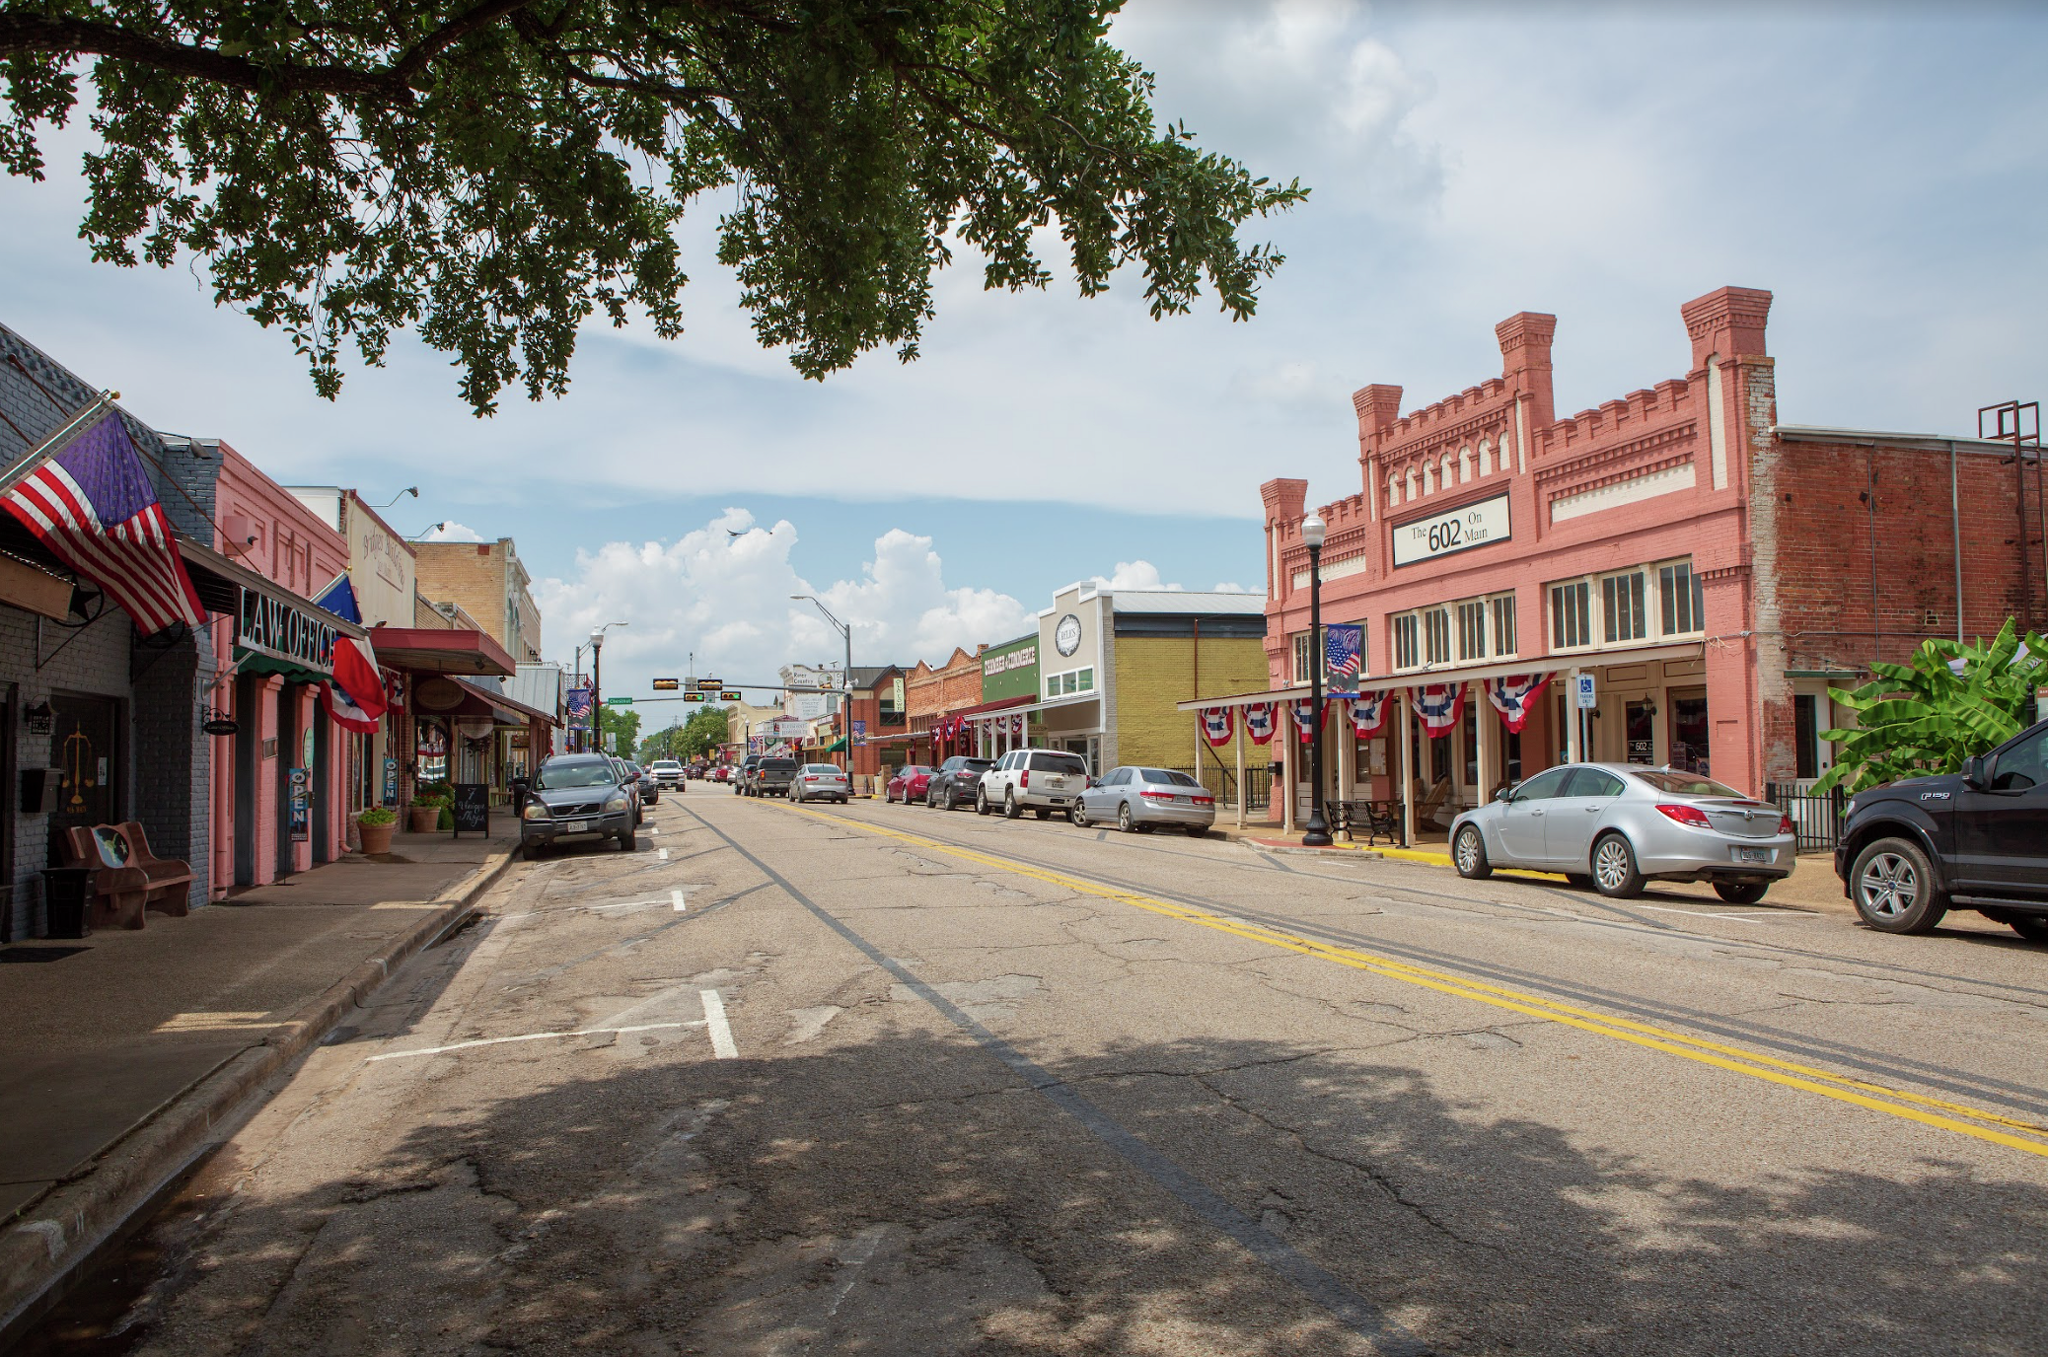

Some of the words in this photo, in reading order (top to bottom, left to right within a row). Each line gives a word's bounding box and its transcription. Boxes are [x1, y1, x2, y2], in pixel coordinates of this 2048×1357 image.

[1468, 511, 1482, 525] On
[1411, 526, 1427, 539] The
[1429, 518, 1461, 552] 602
[1464, 528, 1488, 543] Main
[240, 585, 285, 650] LAW
[984, 656, 1005, 676] CHAMBER
[1008, 646, 1036, 670] COMMERCE
[1635, 742, 1648, 751] 602
[385, 761, 397, 798] OPEN
[467, 787, 477, 800] 7
[292, 772, 306, 822] OPEN
